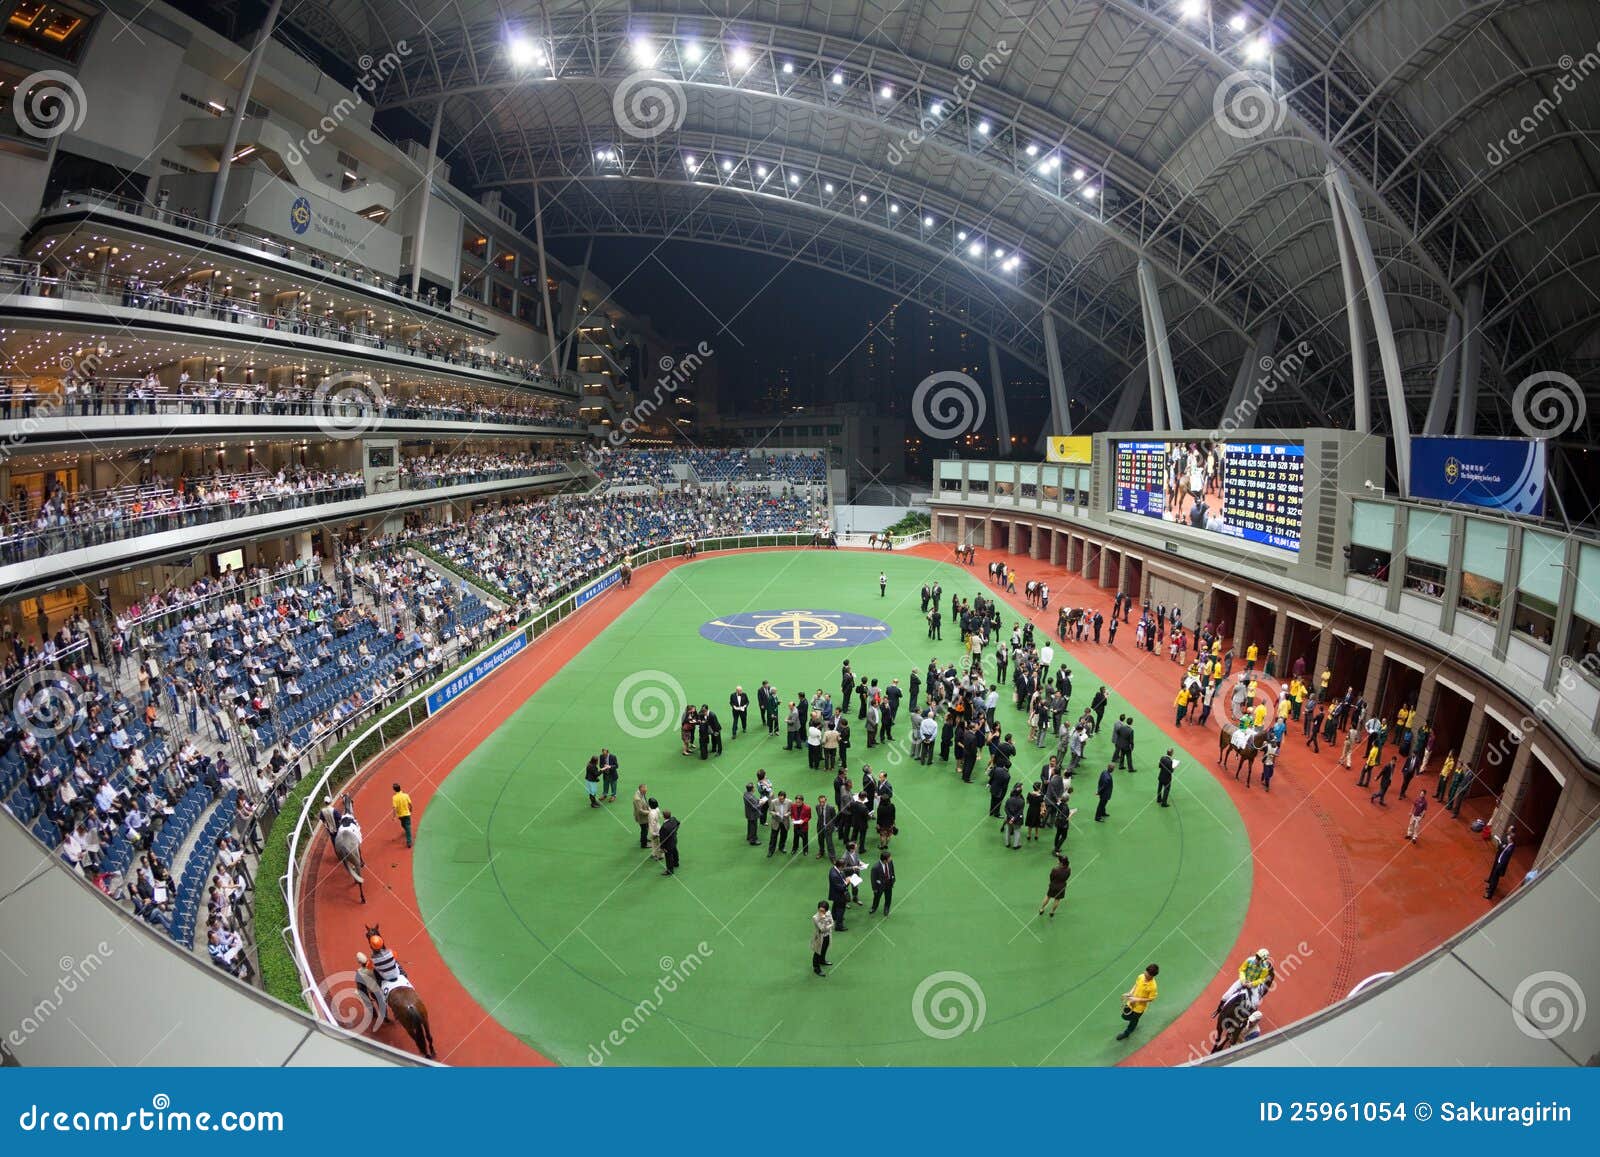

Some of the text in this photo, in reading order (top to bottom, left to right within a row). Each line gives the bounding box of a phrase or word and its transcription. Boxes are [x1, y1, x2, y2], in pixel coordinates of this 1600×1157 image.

[1287, 507, 1297, 515] 322
[1285, 530, 1295, 538] 472
[475, 665, 483, 676] The
[513, 639, 521, 651] Club
